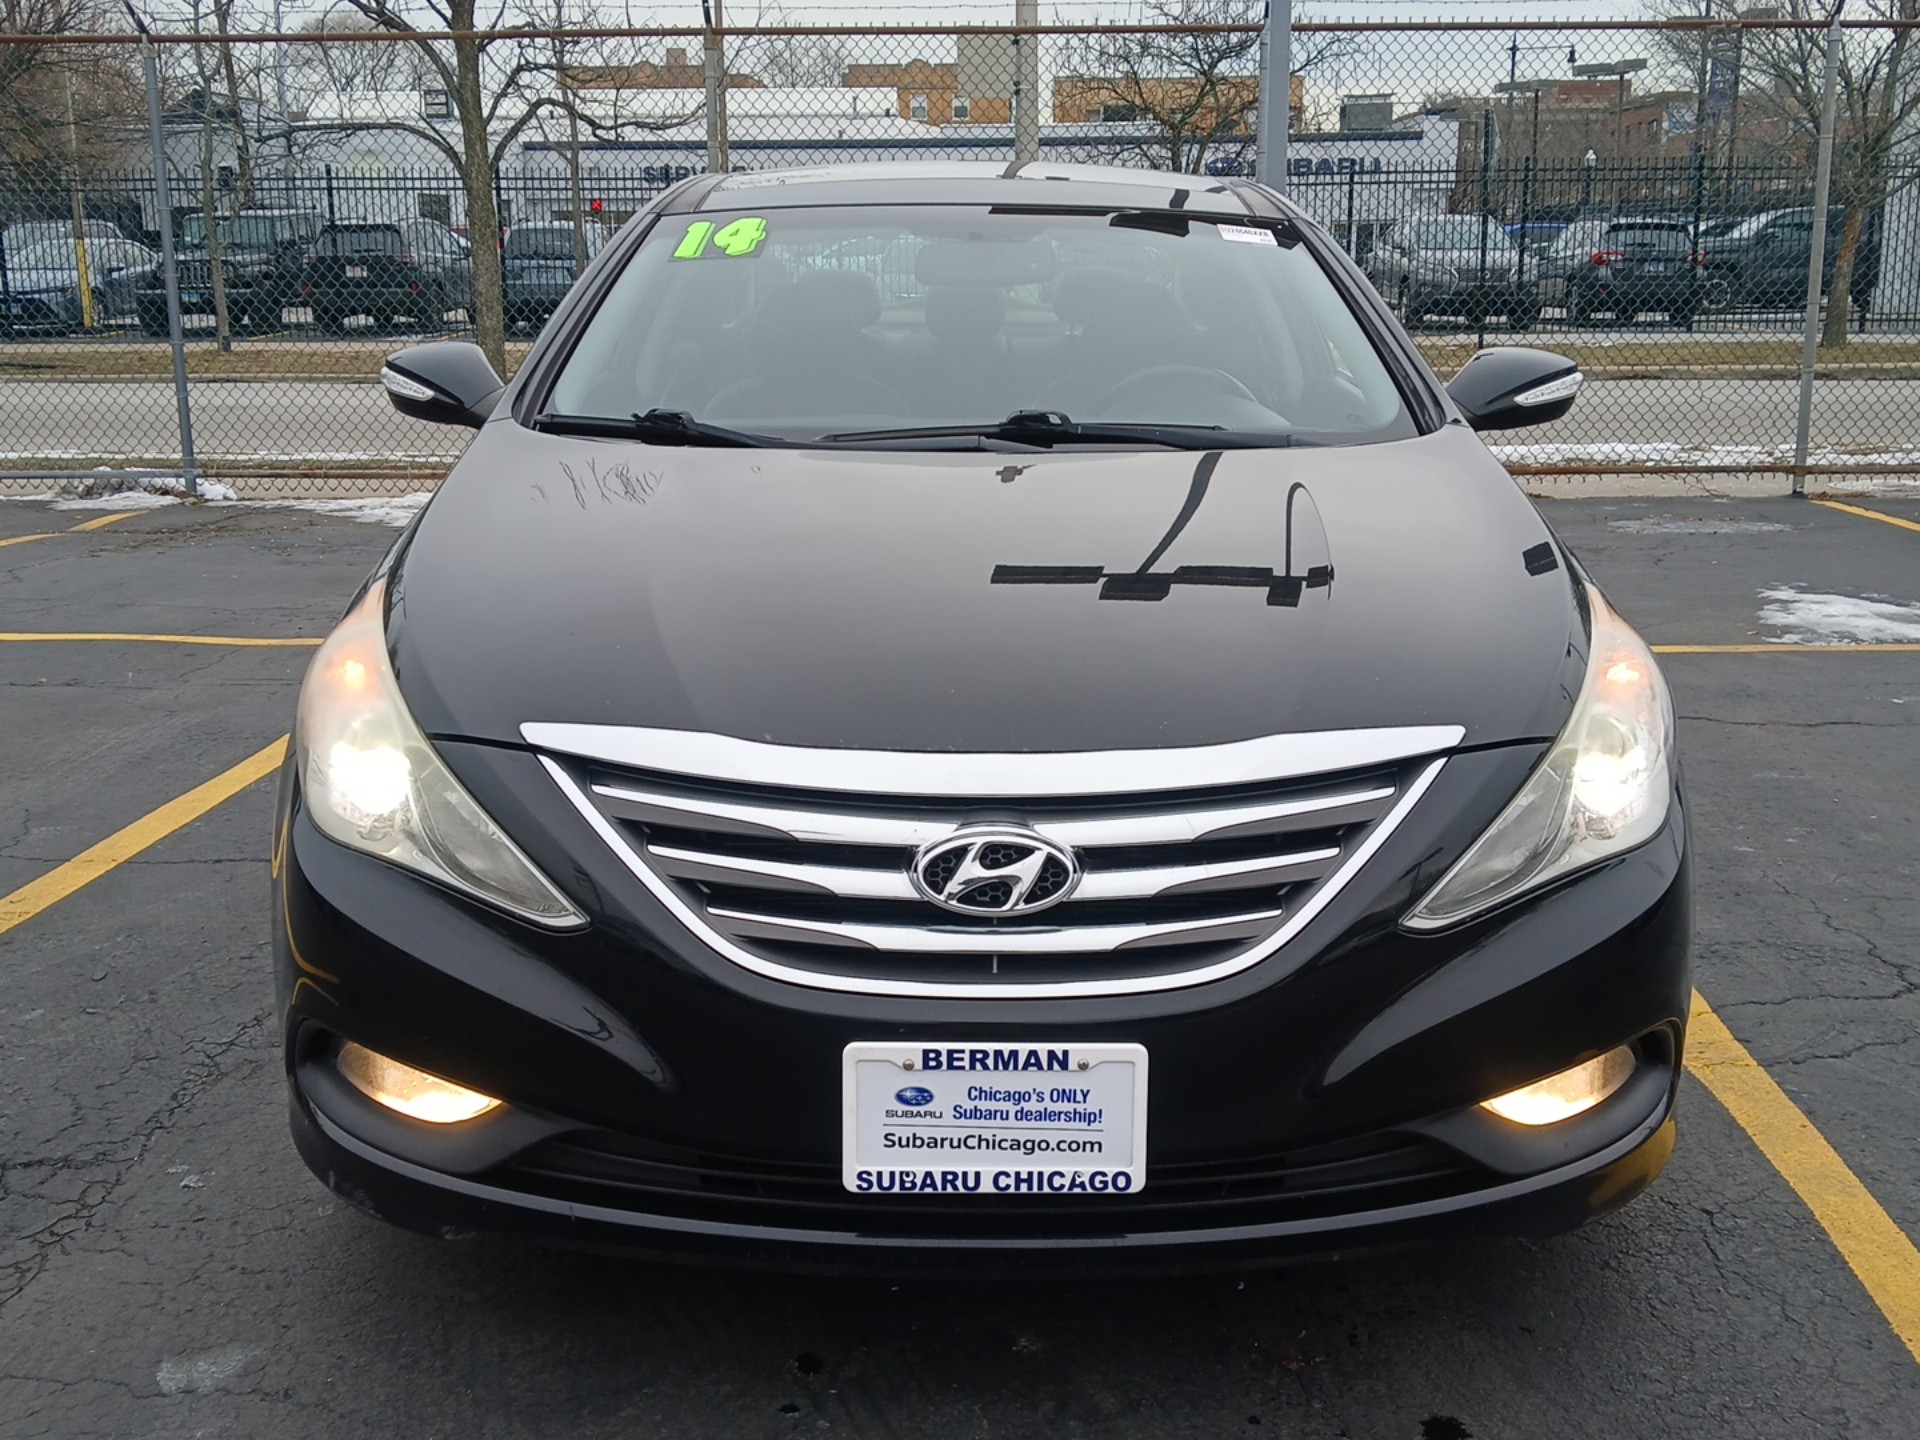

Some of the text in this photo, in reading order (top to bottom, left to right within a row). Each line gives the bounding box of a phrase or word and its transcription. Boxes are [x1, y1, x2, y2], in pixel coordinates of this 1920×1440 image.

[673, 216, 768, 259] 14
[921, 1048, 1070, 1072] BERMAN
[967, 1086, 1091, 1106] Chicago's ONLY
[884, 1109, 944, 1119] SUBARU
[952, 1104, 1103, 1127] Subaru dealership!
[882, 1132, 1103, 1156] SubaruChicago.com
[856, 1170, 1133, 1193] SUBARU CHICAGO
